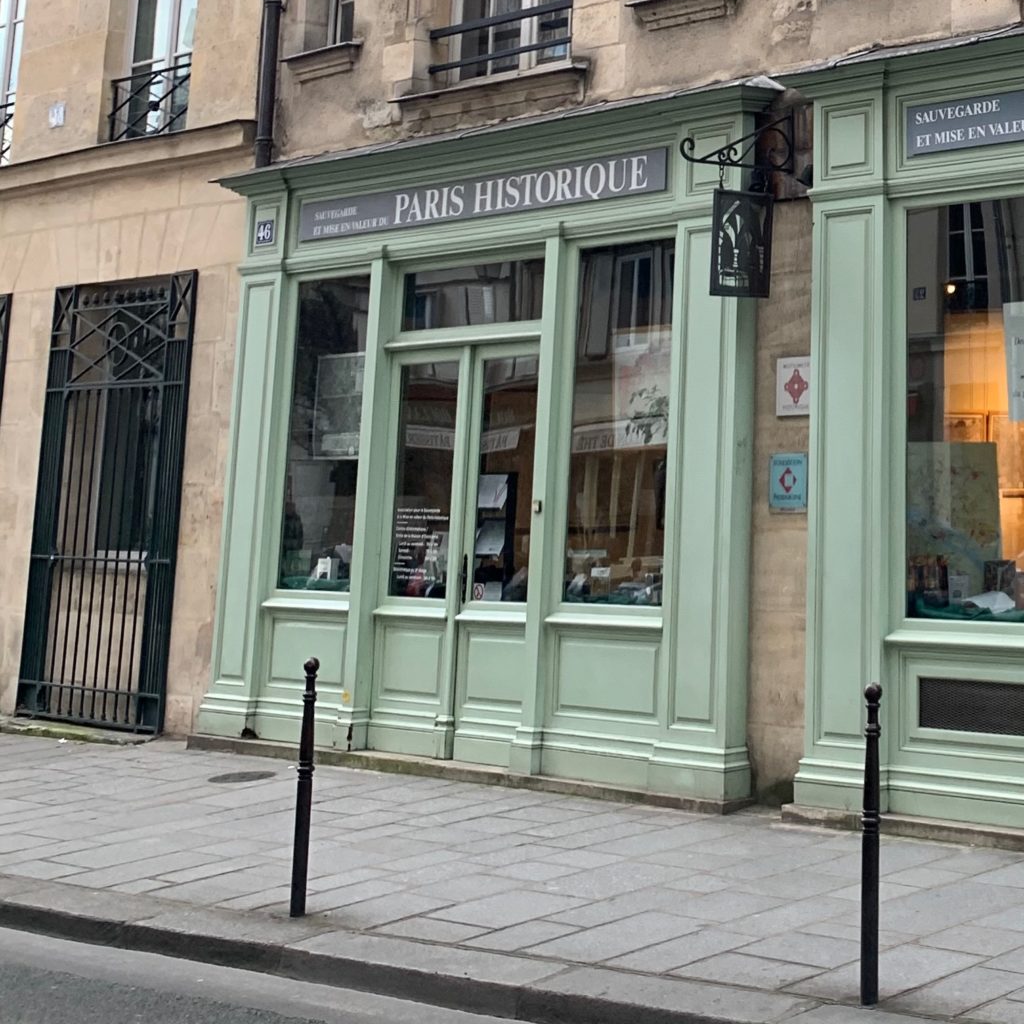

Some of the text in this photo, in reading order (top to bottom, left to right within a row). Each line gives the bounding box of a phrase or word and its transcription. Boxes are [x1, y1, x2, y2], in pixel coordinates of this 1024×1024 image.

[914, 99, 1001, 125] SAUVEGARDE
[916, 134, 933, 148] ET
[934, 127, 965, 146] MISE
[968, 125, 986, 140] EN
[393, 155, 648, 225] PARIS HISTORIQUE
[313, 206, 358, 221] SAUVEGARDE
[257, 223, 271, 241] 46
[313, 216, 389, 236] ET MISE EN VALEUR DU
